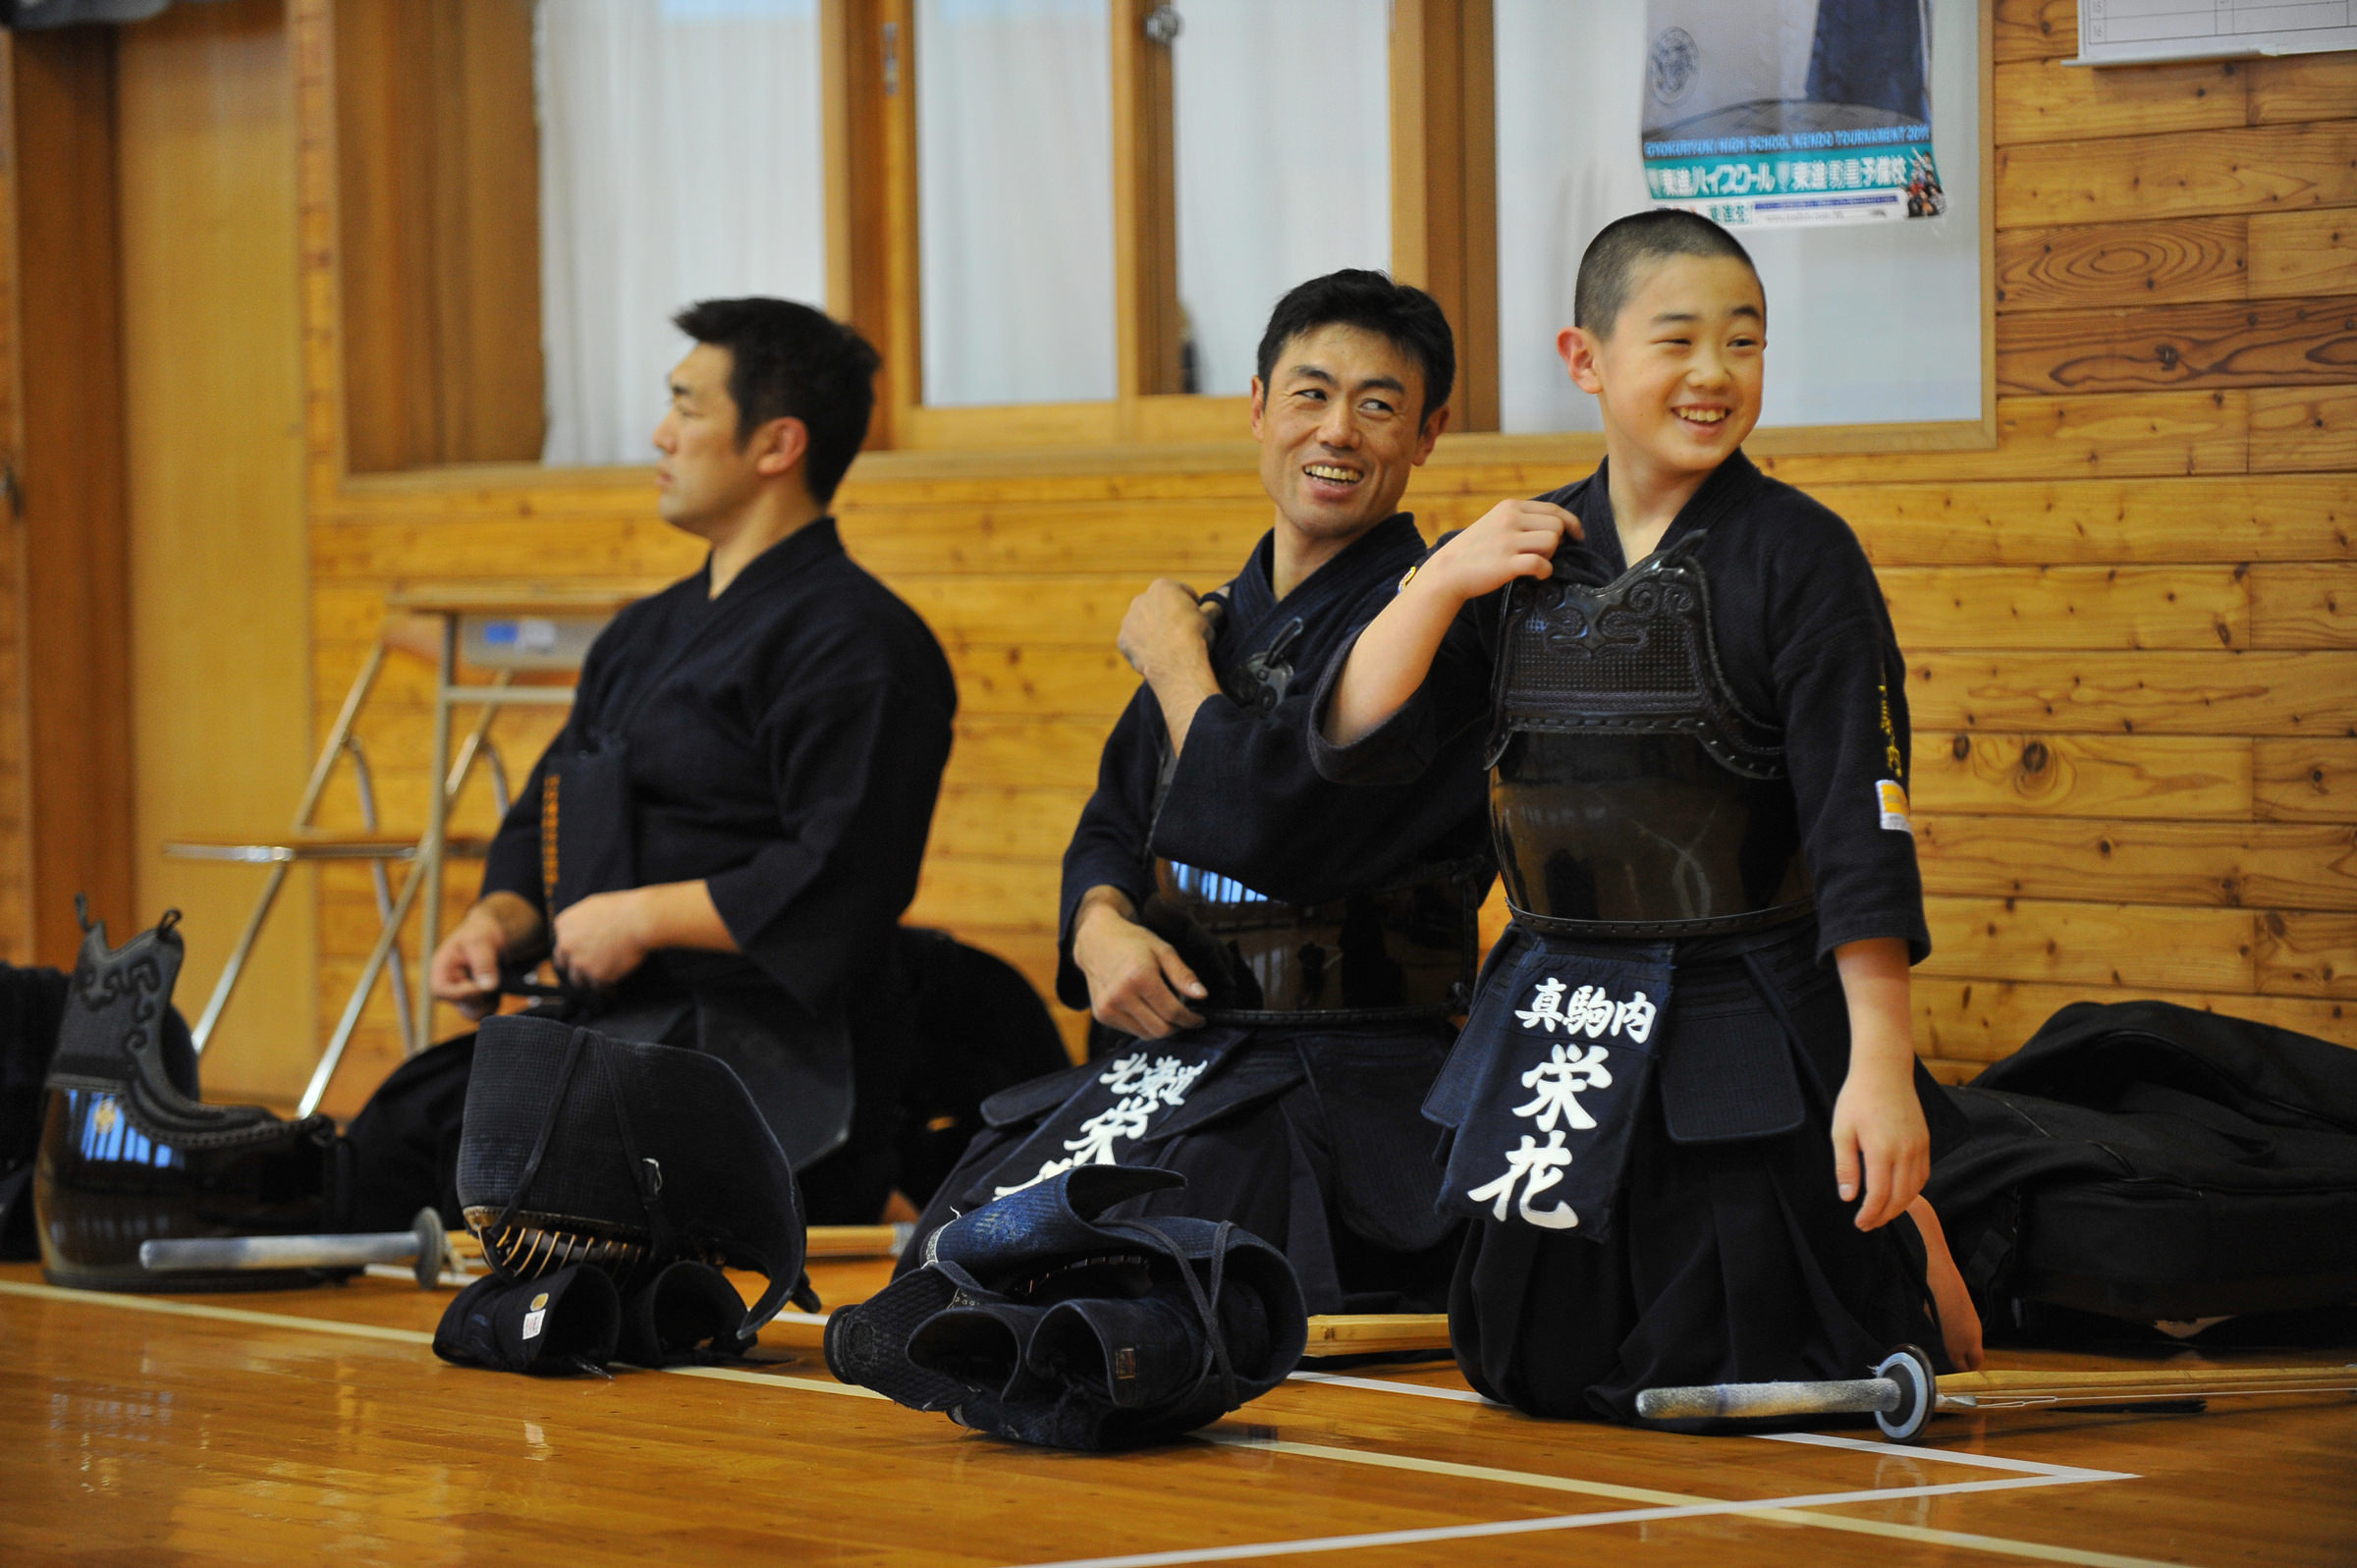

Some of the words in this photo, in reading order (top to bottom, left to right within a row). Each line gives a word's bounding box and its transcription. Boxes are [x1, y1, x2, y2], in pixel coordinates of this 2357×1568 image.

[1749, 134, 1790, 151] SCHOOL
[1792, 131, 1834, 149] KENDO
[1835, 125, 1905, 145] TOURNAMENT
[1514, 977, 1657, 1044] 真駒内
[1099, 1053, 1208, 1106] 北海道
[1467, 1044, 1613, 1229] 栄花
